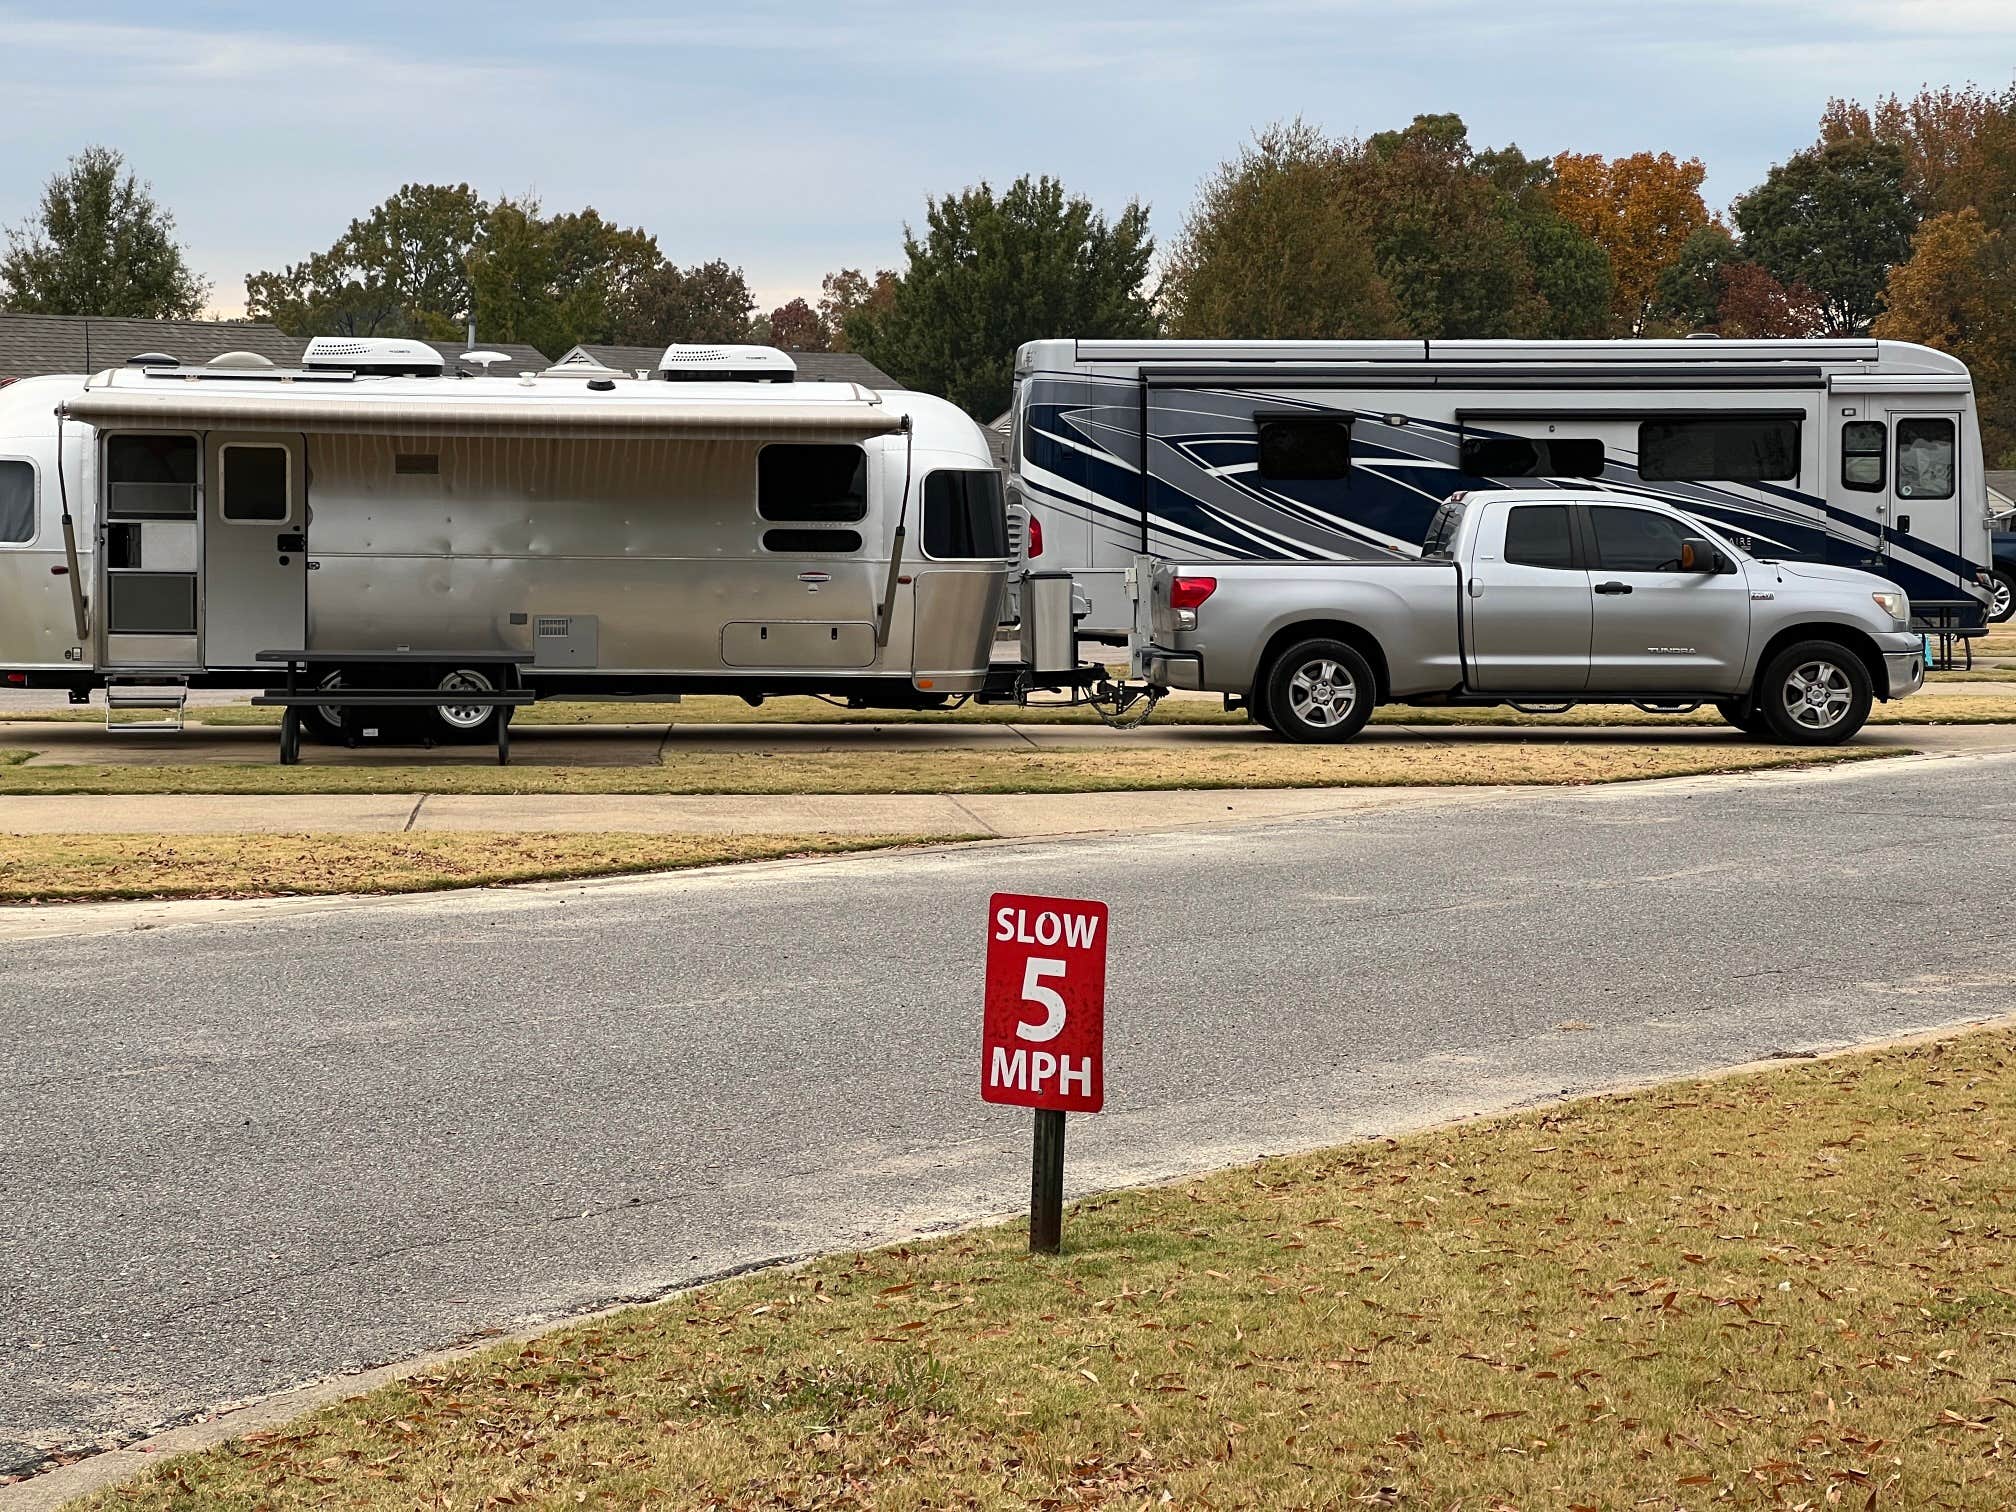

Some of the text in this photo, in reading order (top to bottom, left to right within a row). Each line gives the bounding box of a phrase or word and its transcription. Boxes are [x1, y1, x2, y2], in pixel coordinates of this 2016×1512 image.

[1647, 647, 1697, 655] TUNDRA
[995, 907, 1099, 949] SLOW
[1016, 957, 1067, 1042] 5
[990, 1047, 1091, 1097] MPH
